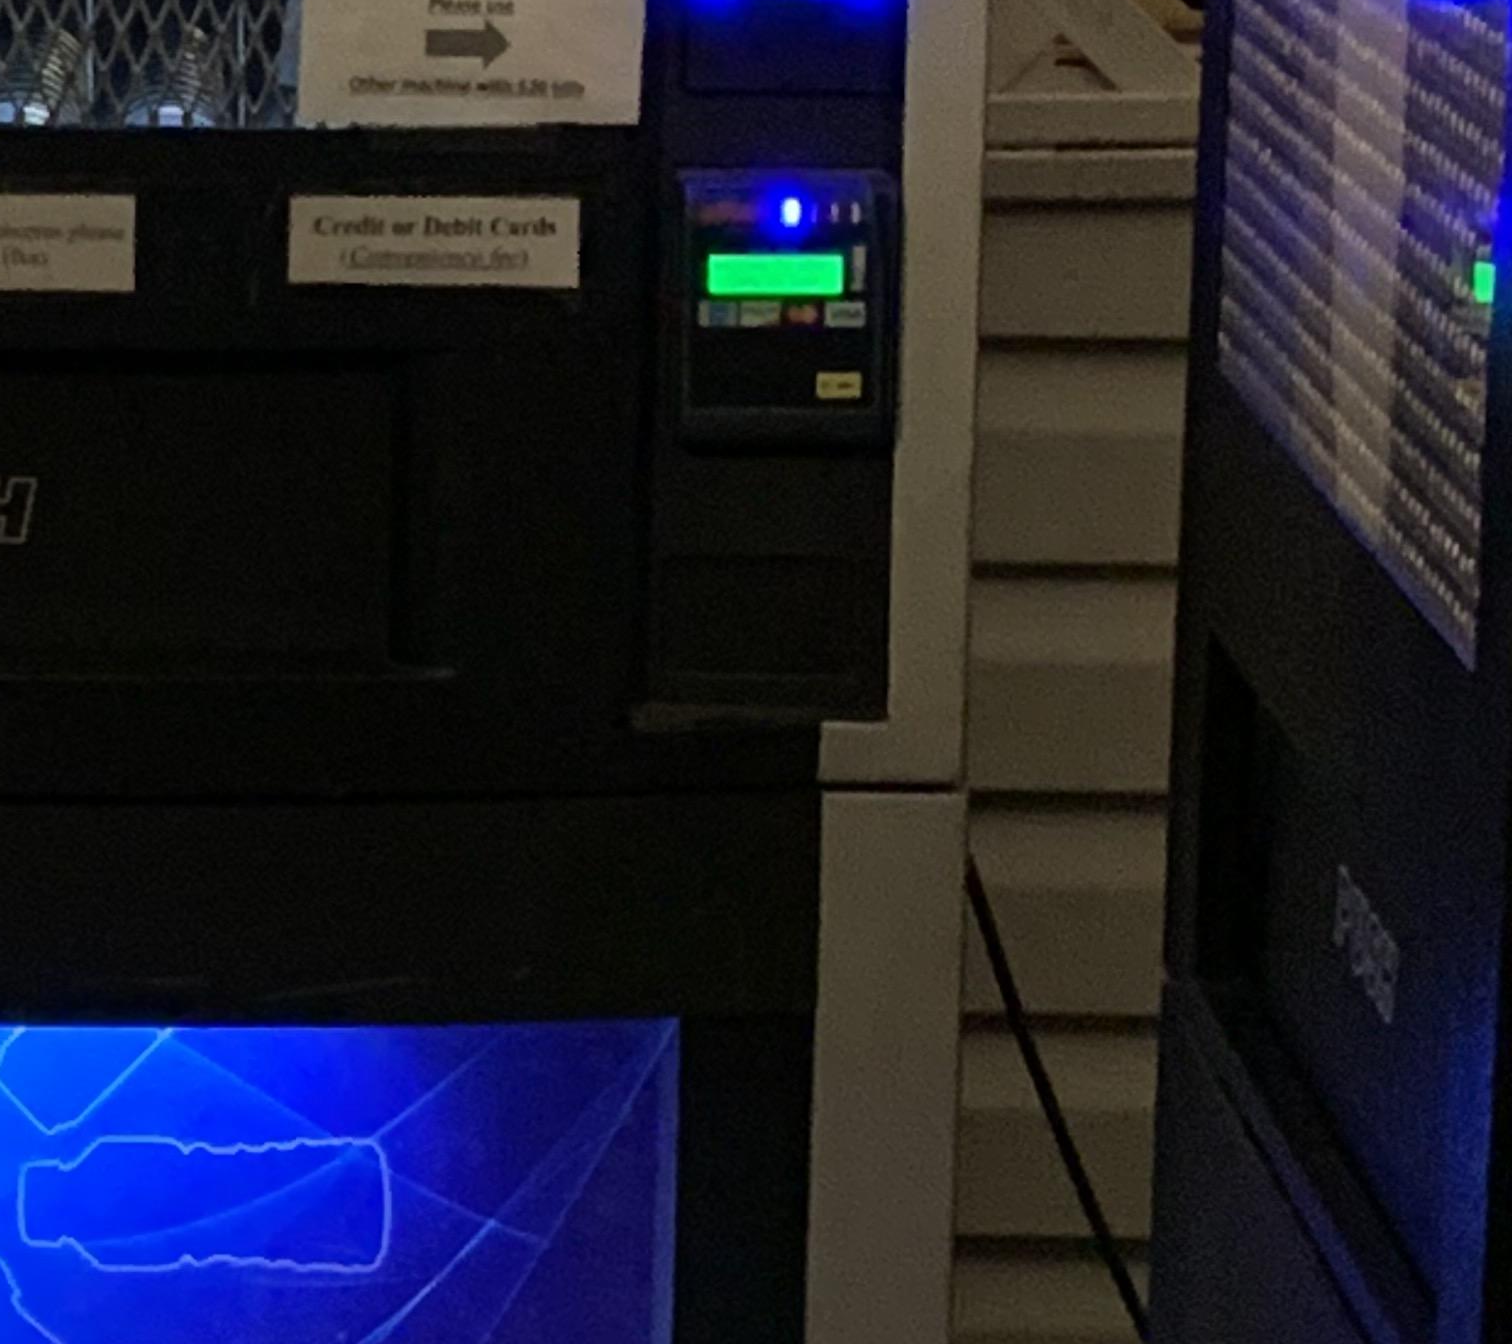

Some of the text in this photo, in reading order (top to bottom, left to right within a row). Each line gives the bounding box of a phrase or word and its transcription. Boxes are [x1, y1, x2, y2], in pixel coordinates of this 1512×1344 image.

[486, 0, 515, 16] use
[349, 75, 397, 96] Other
[313, 214, 557, 236] Credit or Debit Cards
